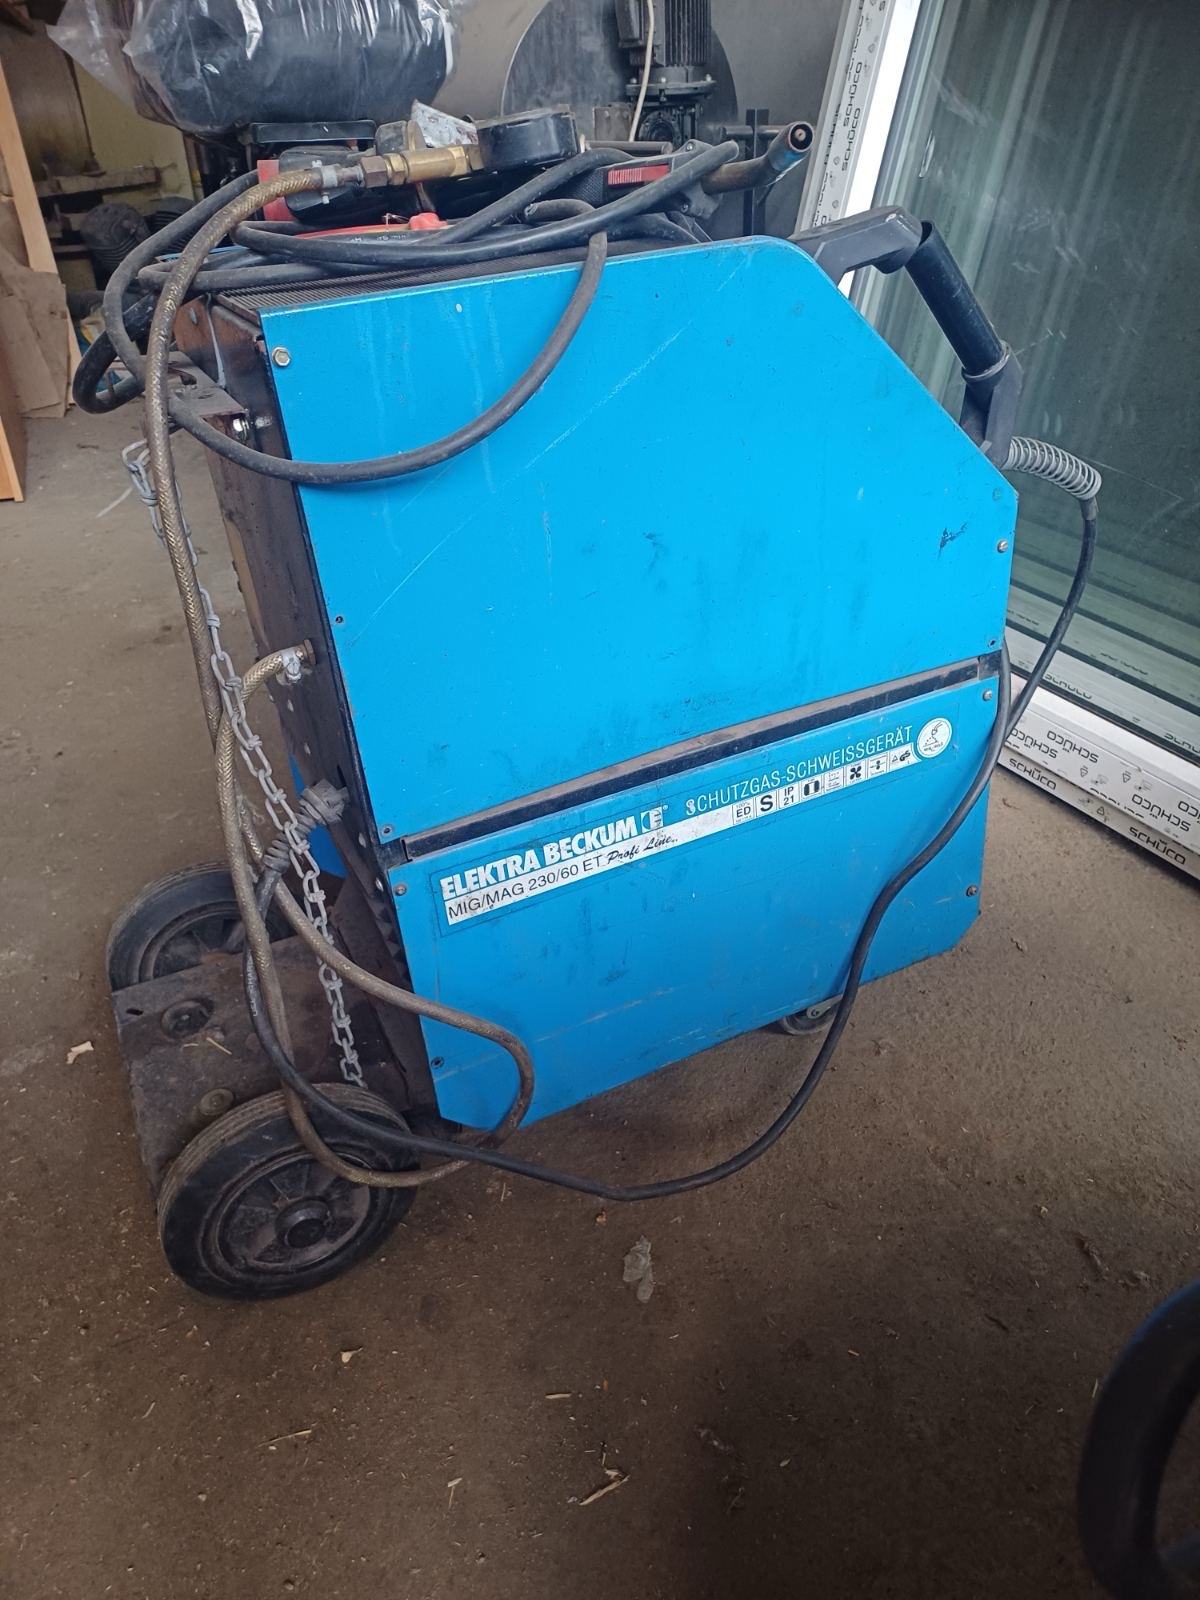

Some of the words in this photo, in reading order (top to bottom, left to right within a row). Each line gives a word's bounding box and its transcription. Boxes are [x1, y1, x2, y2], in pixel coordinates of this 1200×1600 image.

[1046, 730, 1099, 764] SCHÜCO
[685, 726, 913, 816] SCHUTZGAS-SCHWEISSGERÄT
[1009, 758, 1057, 790] SCHÜCO
[759, 794, 774, 812] S
[783, 796, 795, 806] 21
[784, 786, 794, 797] IP
[736, 805, 751, 818] ED
[1131, 794, 1191, 832] SCHÜCO
[440, 849, 541, 900] ELEKTRA
[543, 816, 637, 867] BECKUM
[1129, 827, 1187, 865] SCHÜCO
[448, 883, 524, 919] MIG/MAG
[528, 864, 578, 891] 230/60
[583, 856, 603, 872] ET
[607, 845, 640, 864] Profi
